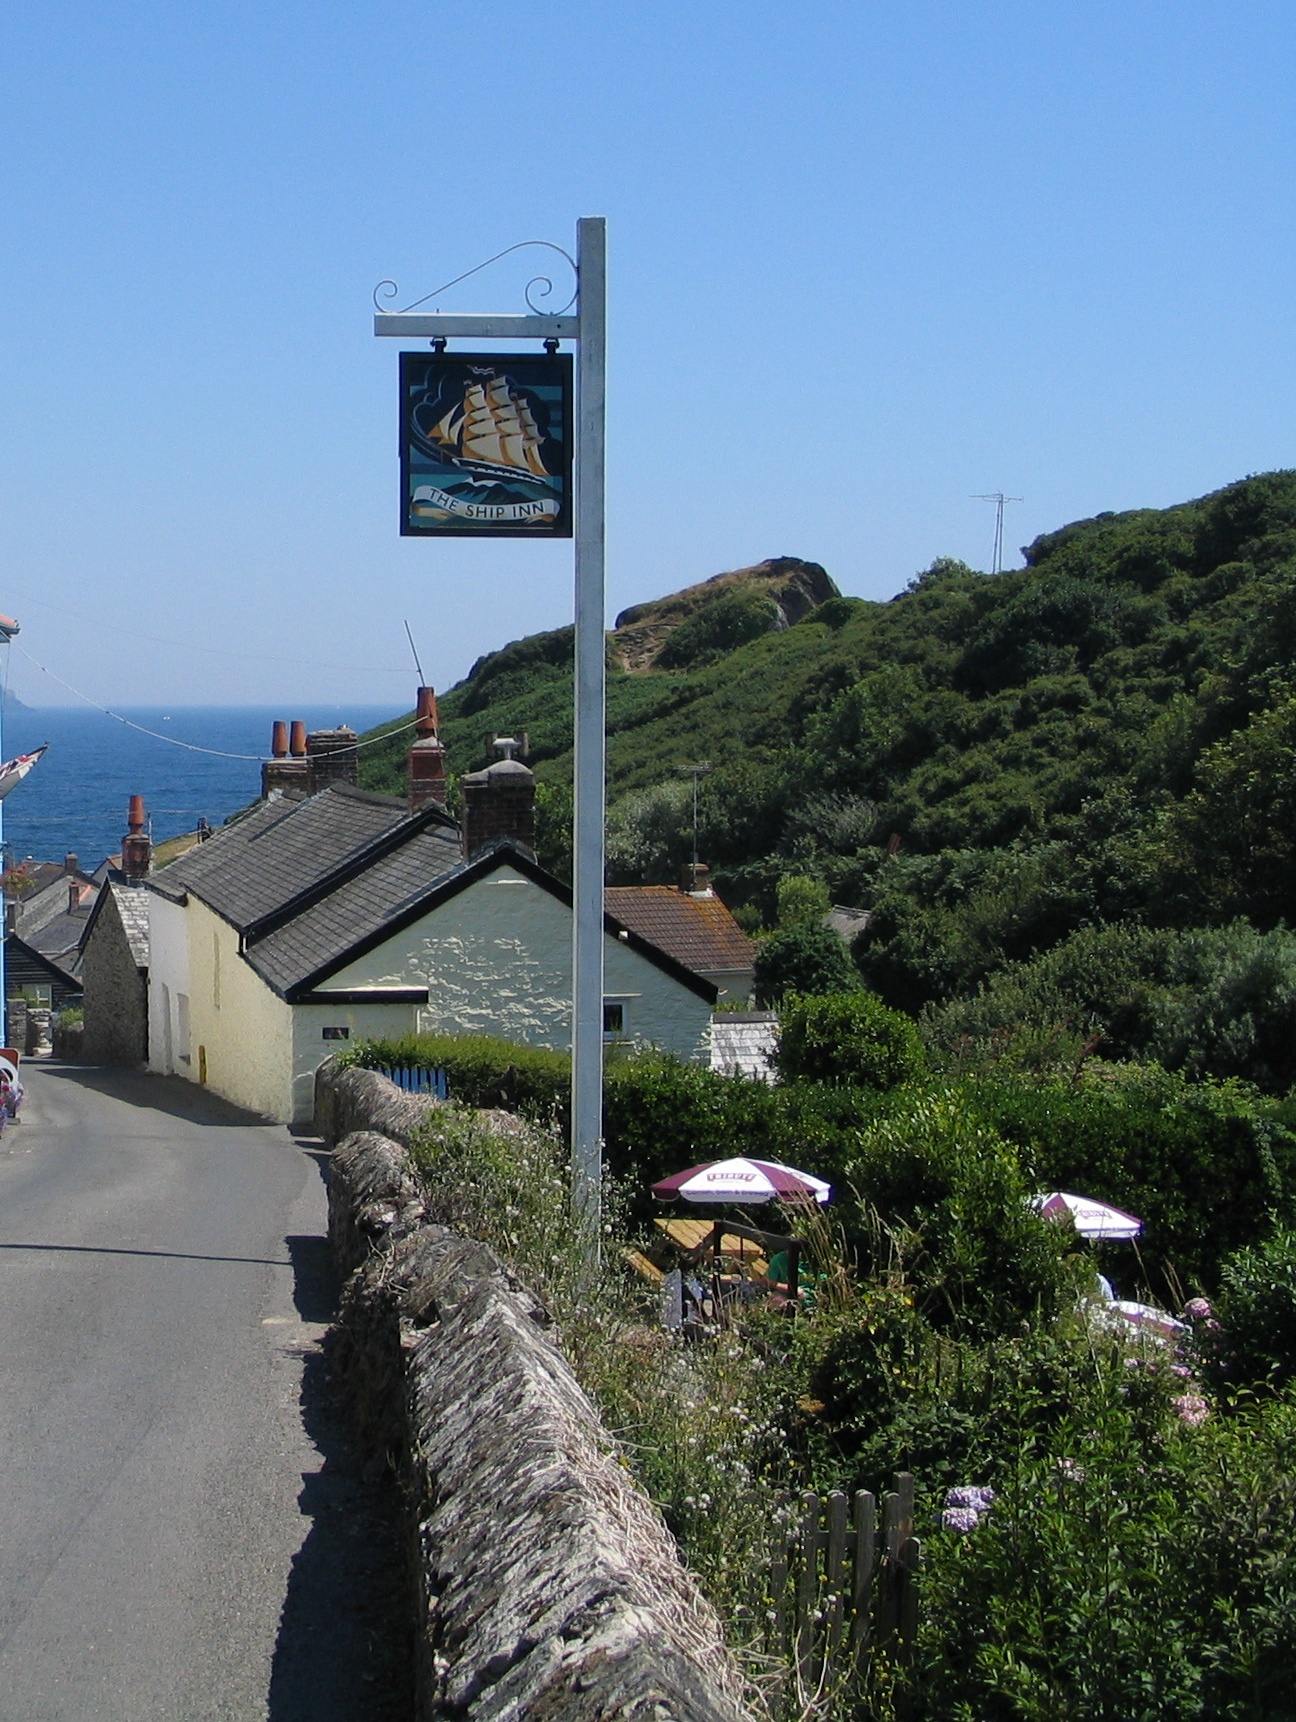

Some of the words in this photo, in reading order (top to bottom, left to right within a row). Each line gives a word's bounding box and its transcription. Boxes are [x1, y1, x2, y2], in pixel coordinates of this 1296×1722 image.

[429, 488, 459, 512] THE
[465, 505, 505, 518] SHIP
[512, 502, 545, 517] INN
